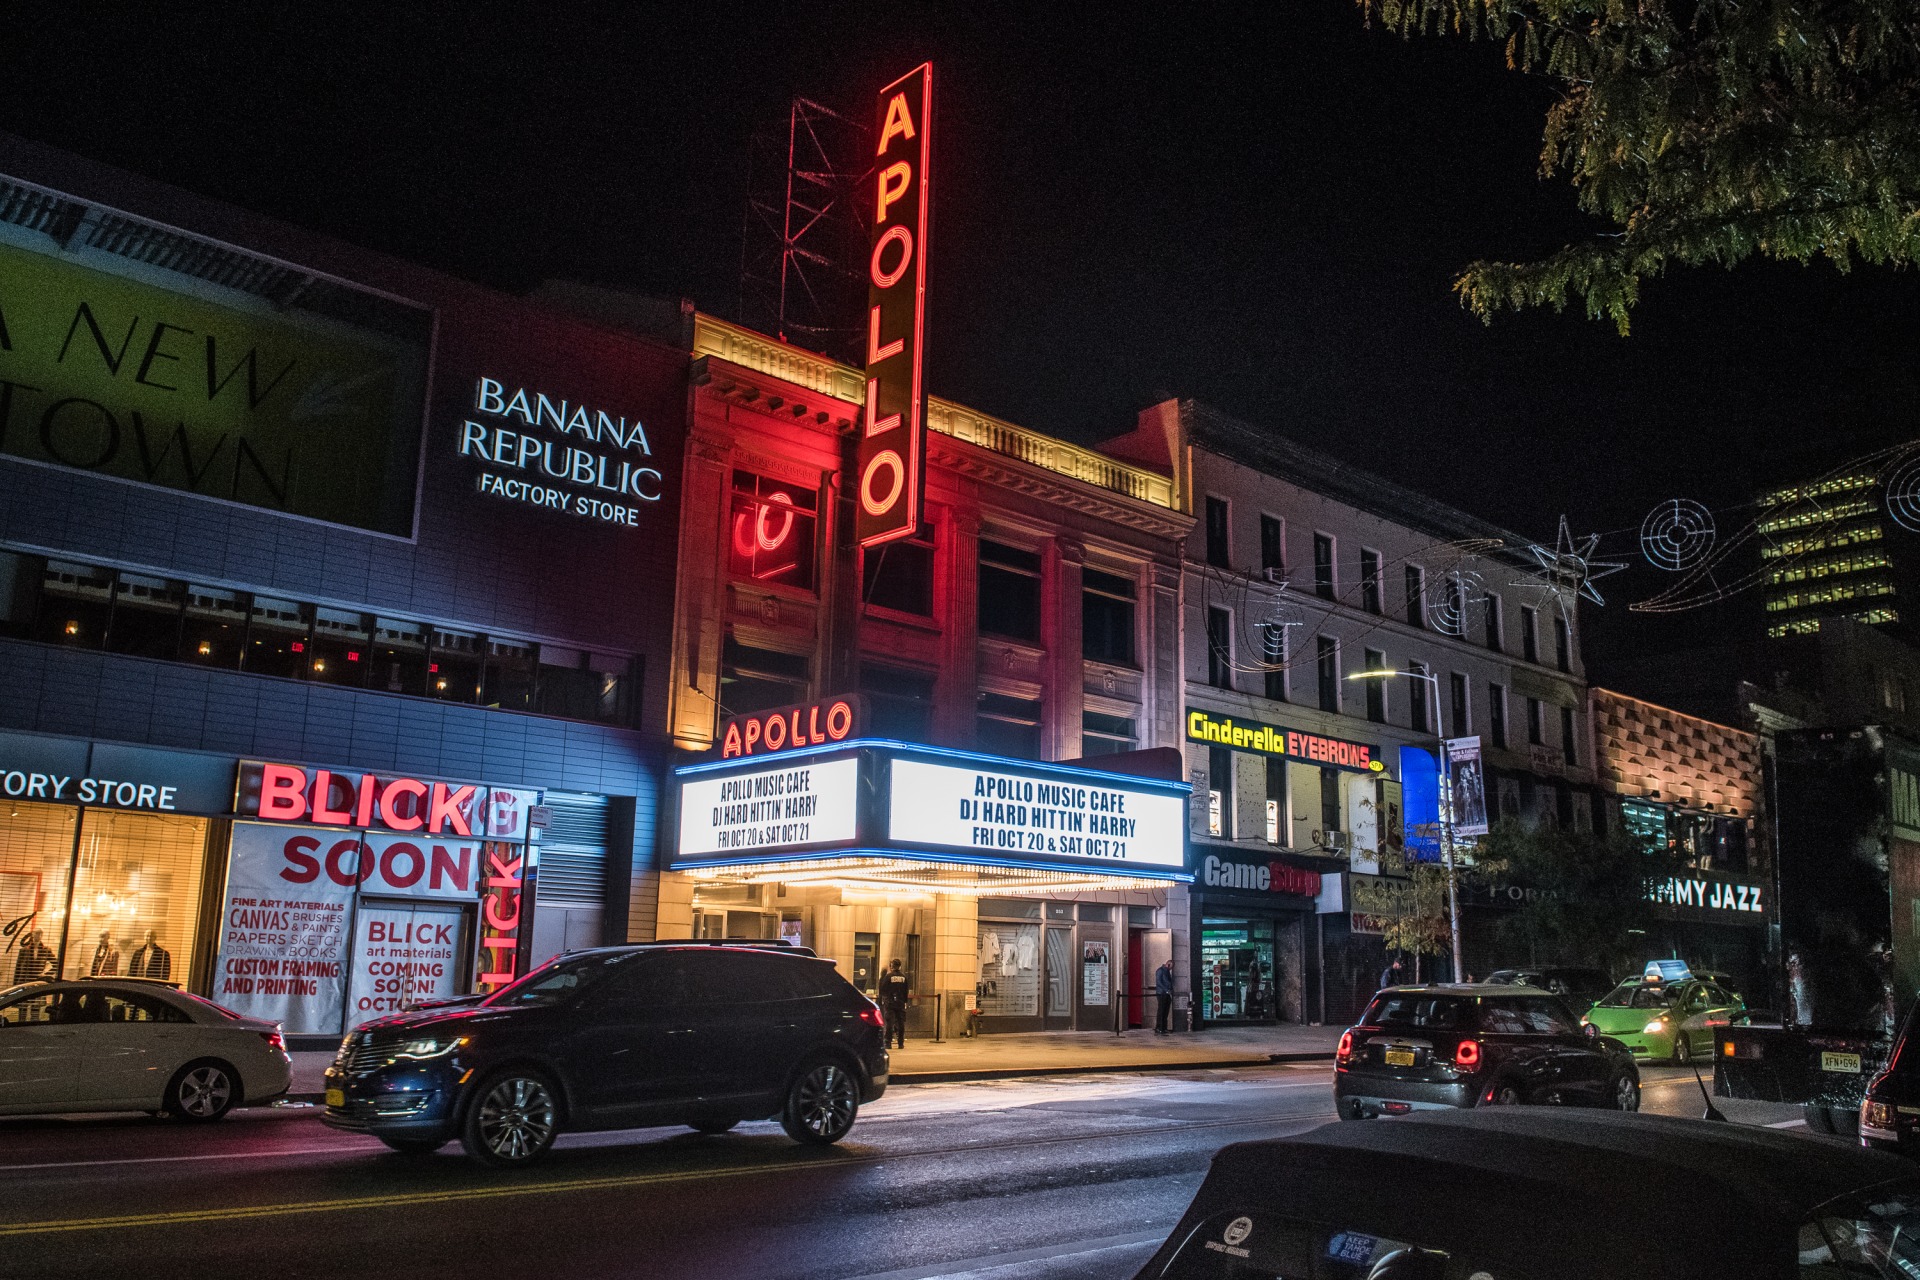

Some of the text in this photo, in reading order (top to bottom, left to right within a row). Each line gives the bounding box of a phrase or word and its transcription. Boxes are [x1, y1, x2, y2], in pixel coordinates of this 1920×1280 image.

[860, 91, 915, 517] APOLLO
[58, 301, 297, 409] NEW
[477, 377, 652, 456] BANANA
[0, 380, 292, 506] TOWN
[460, 420, 662, 500] REPUBLIC
[480, 473, 639, 527] FACTORY STORE
[723, 701, 852, 759] APOLLO
[1188, 711, 1382, 771] Cinderella EYEBROWS SPA
[0, 770, 178, 811] ORY STORE
[258, 764, 478, 837] BLICK
[720, 770, 810, 802] APOLLO MUSIC CAFE
[974, 775, 1125, 814] APOLLO MUSIC CAFE
[712, 795, 818, 827] DJ HARD HITTIN' HARRY
[960, 798, 1136, 838] DJ HARD HITTIN' HARRY
[718, 822, 809, 849] FRI OCT 20 & SAT OCT 21
[973, 826, 1126, 858] FRI OCT 20 & SAT OCT 21
[1204, 854, 1322, 898] GameStop
[231, 897, 345, 912] FINE ART MATERIALS
[1710, 882, 1763, 912] JAZZ
[229, 908, 290, 931] CANVAS
[291, 923, 341, 934] & PAINTS
[292, 912, 343, 924] BRUSHES
[367, 921, 454, 945] BLICK
[481, 851, 523, 984] LICK
[226, 945, 337, 958] DRAWING BOOKS
[227, 931, 343, 947] PAPERS SKETCH
[366, 946, 452, 959] art materials
[225, 957, 341, 978] CUSTOM FRAMING
[368, 961, 444, 978] COMING
[223, 977, 318, 996] AND PRINTING
[373, 978, 435, 994] SOON!
[358, 996, 438, 1012] OCTO
